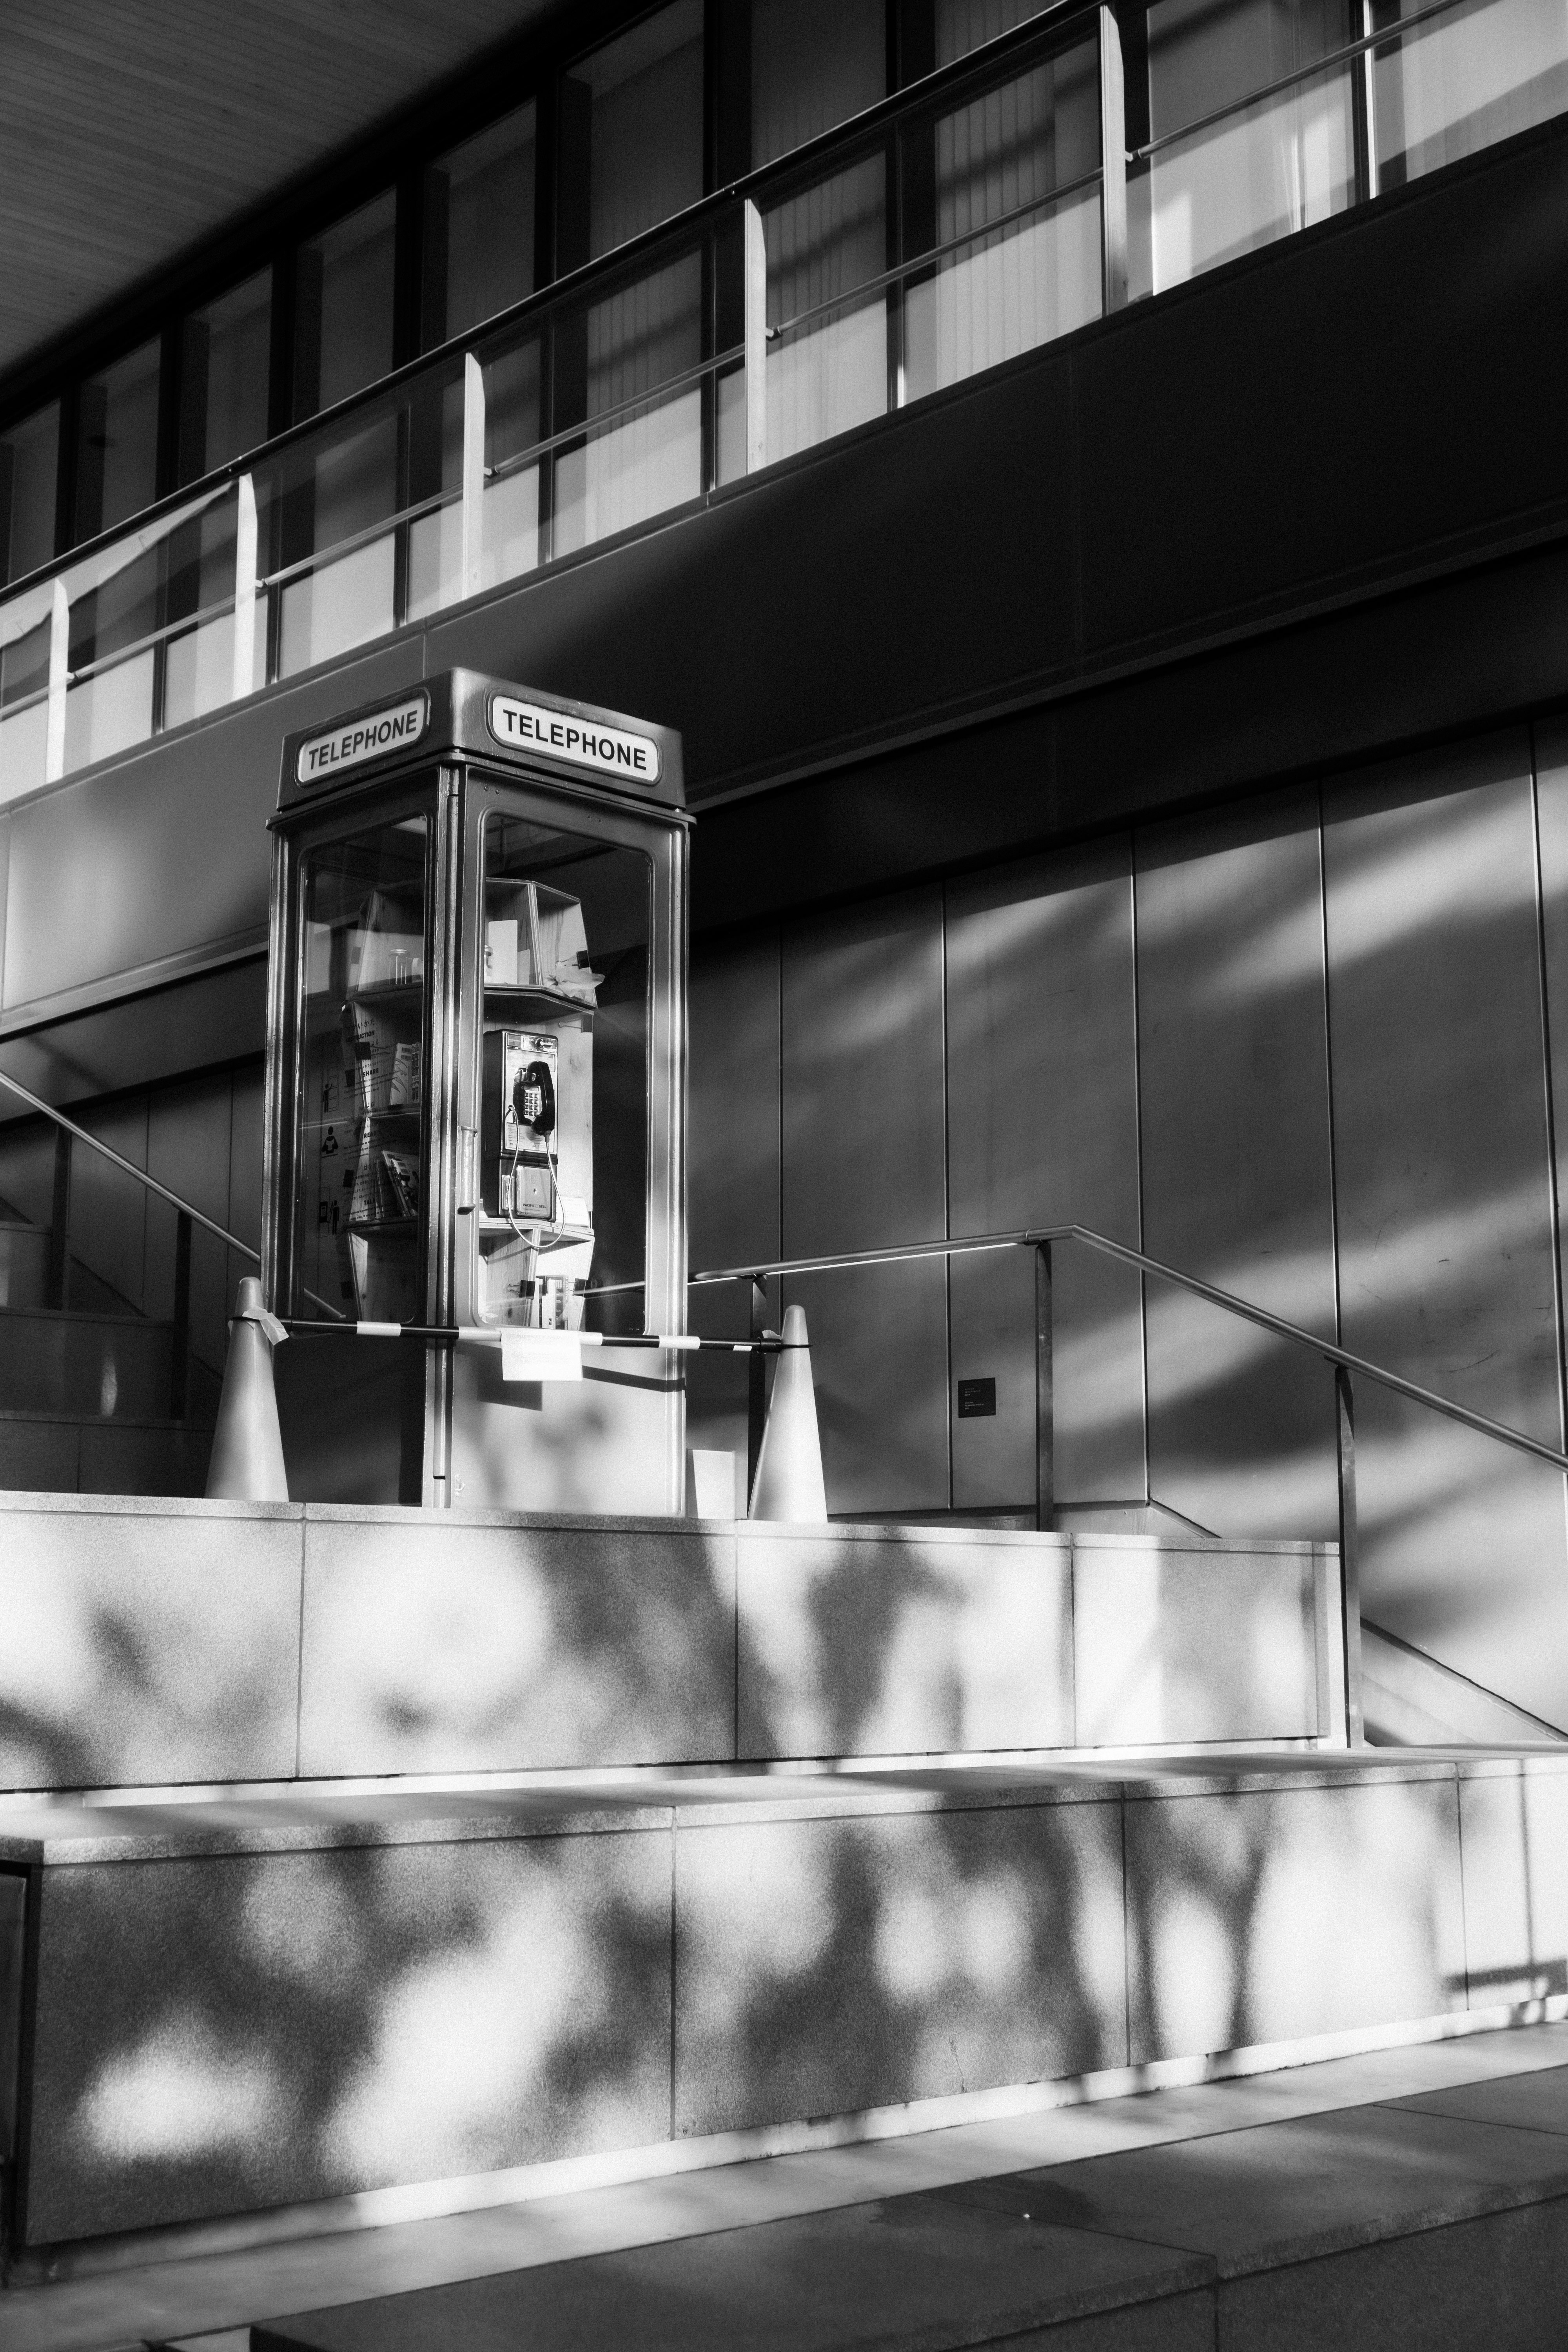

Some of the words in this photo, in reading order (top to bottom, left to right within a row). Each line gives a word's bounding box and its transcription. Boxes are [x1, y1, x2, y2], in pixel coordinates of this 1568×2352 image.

[308, 710, 418, 770] TELEPHONE
[503, 709, 646, 770] TELEPHONE
[363, 1068, 379, 1077] SHARE
